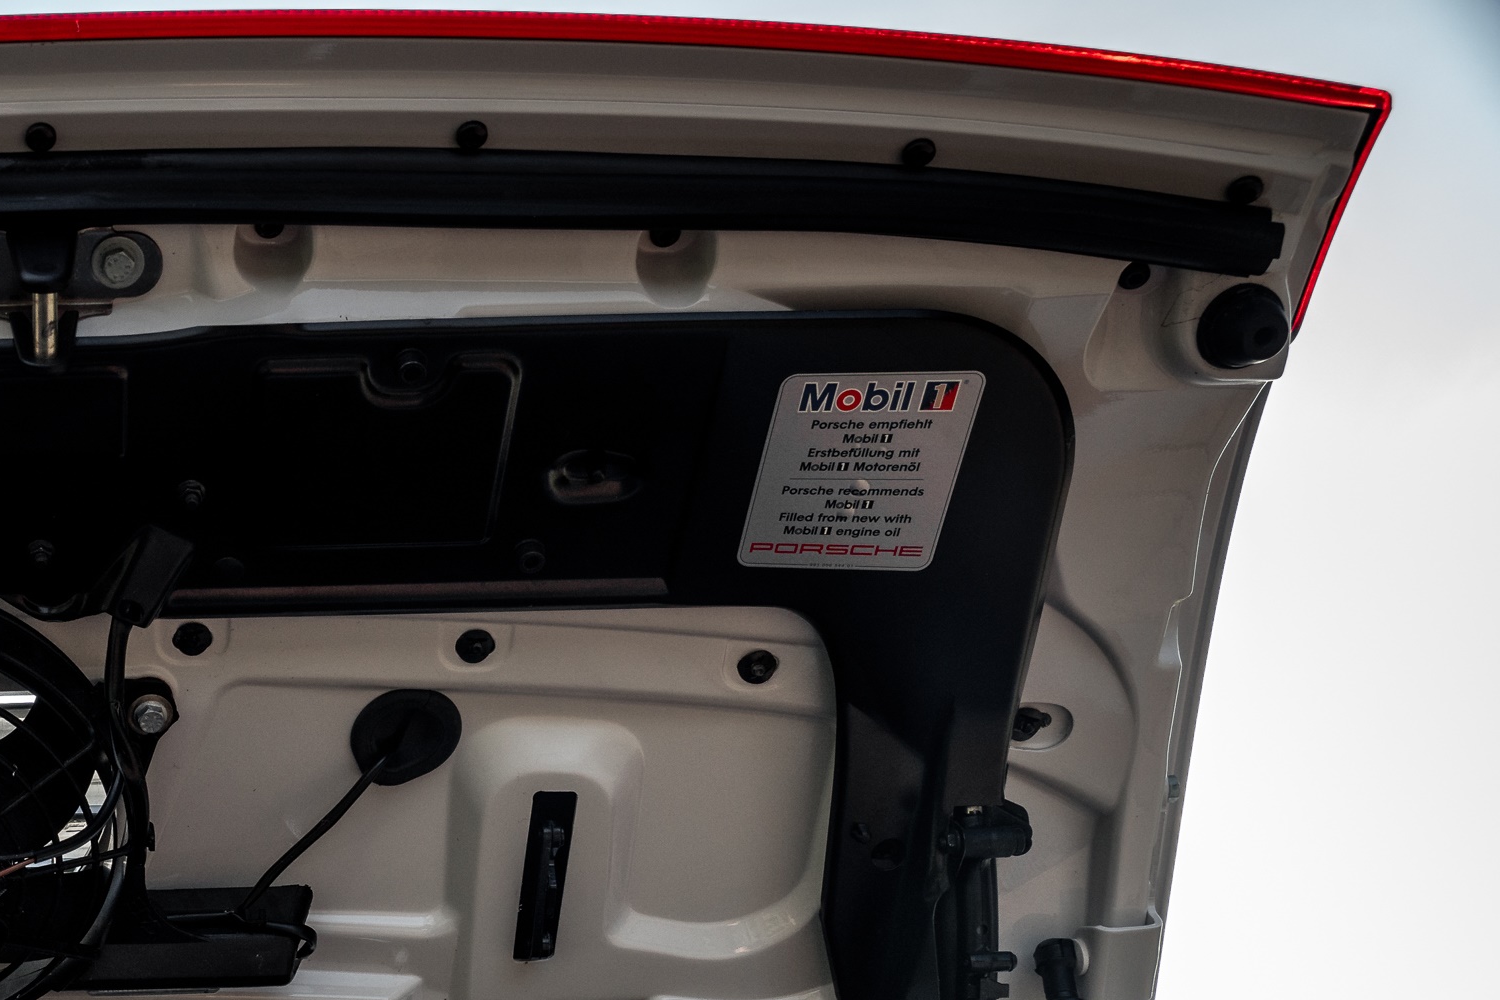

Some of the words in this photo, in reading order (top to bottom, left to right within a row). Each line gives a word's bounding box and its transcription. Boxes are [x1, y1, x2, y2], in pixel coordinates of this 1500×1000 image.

[798, 381, 916, 413] Mobil
[811, 420, 864, 430] Porsche
[869, 420, 933, 431] empfiehlt
[842, 434, 878, 443] Mobil
[880, 434, 893, 443] 1
[807, 448, 894, 459] Erstbefüllung
[898, 448, 920, 458] mit
[799, 462, 834, 471] Mobil
[837, 462, 849, 471] 1
[853, 462, 920, 472] Motorenöl
[782, 486, 833, 495] Porsche
[838, 486, 924, 496] recommends
[824, 500, 859, 509] Mobil
[861, 500, 874, 509] 1
[779, 513, 813, 522] Filled
[818, 513, 847, 522] from
[884, 514, 912, 524] with
[783, 526, 818, 535] Mobil
[820, 527, 832, 535] 1
[836, 528, 880, 538] engine
[885, 528, 900, 537] oil
[749, 543, 923, 556] PORSCHE
